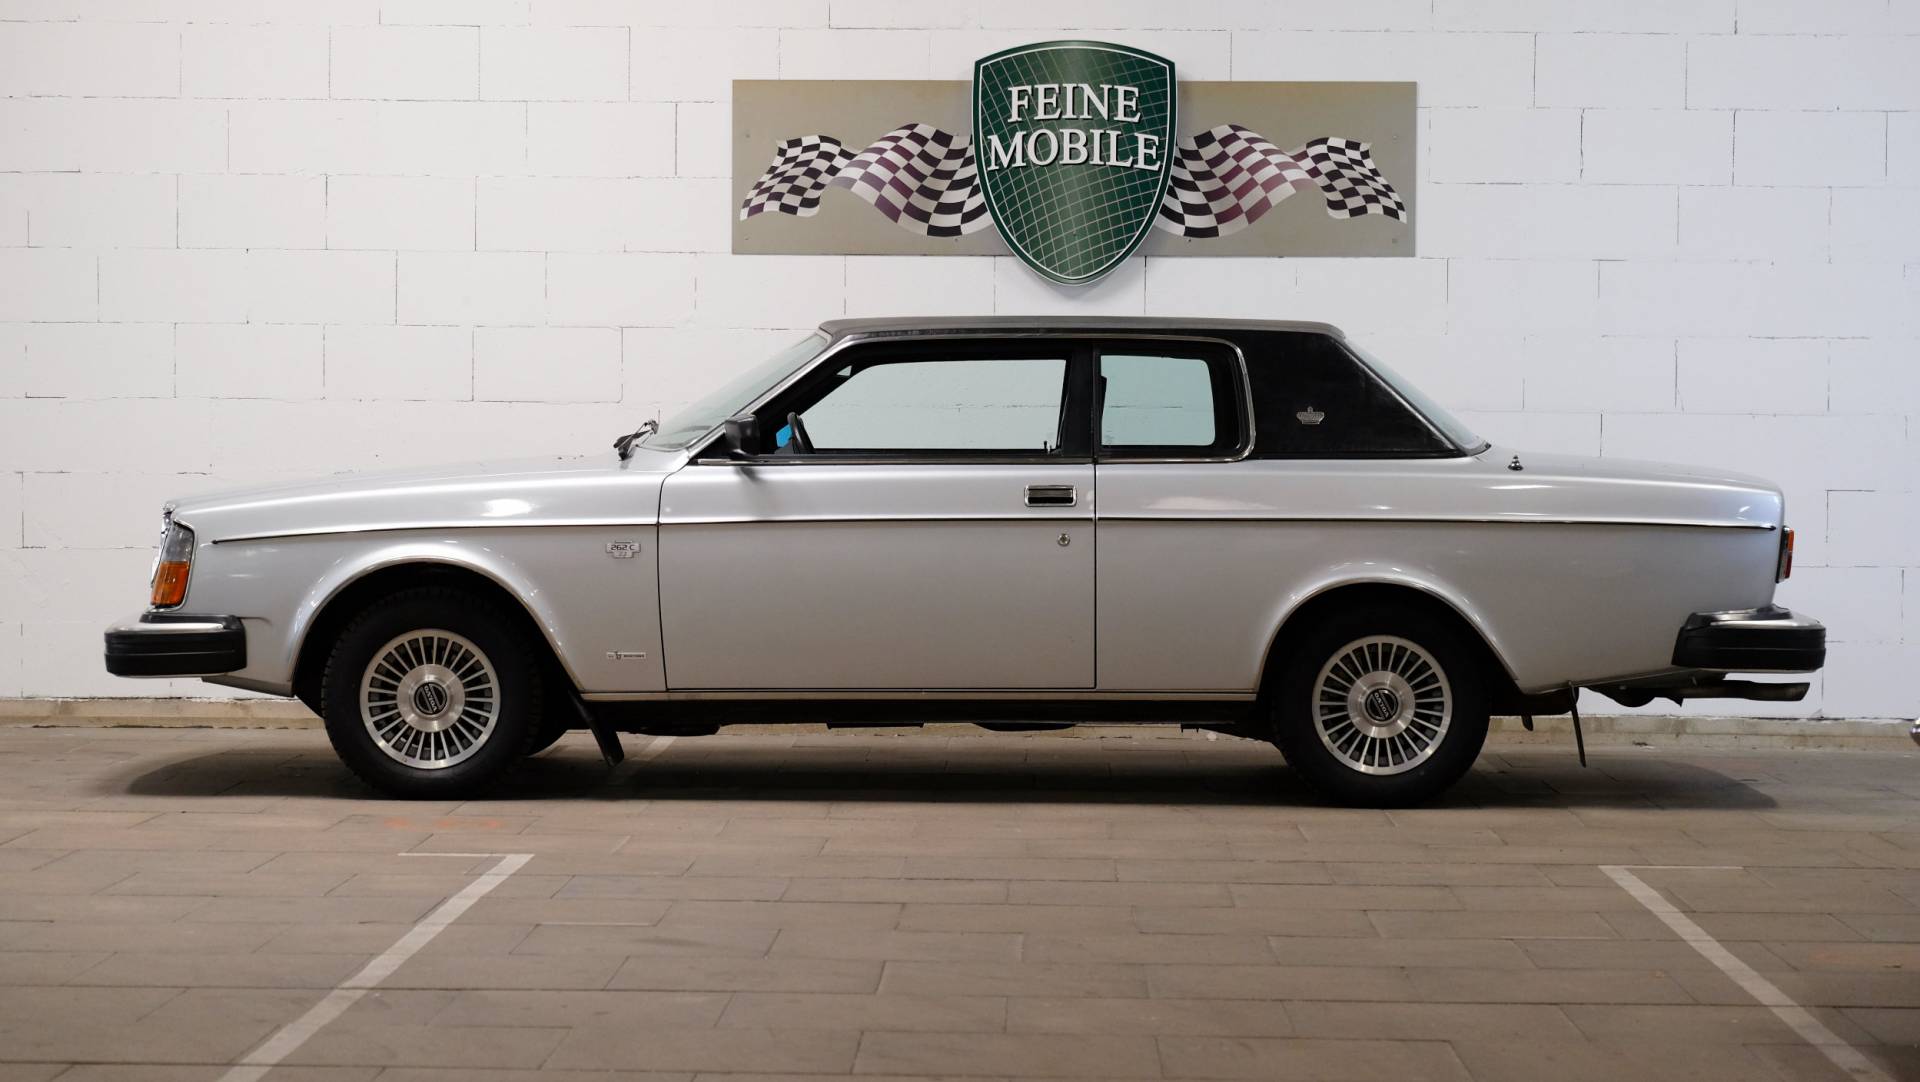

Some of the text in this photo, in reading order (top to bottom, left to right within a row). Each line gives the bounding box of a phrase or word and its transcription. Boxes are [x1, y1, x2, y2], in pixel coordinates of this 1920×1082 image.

[1007, 83, 1142, 123] FEINE
[987, 128, 1161, 172] MOBILE
[423, 684, 438, 712] VOLVO
[1374, 692, 1389, 718] VOLVO
